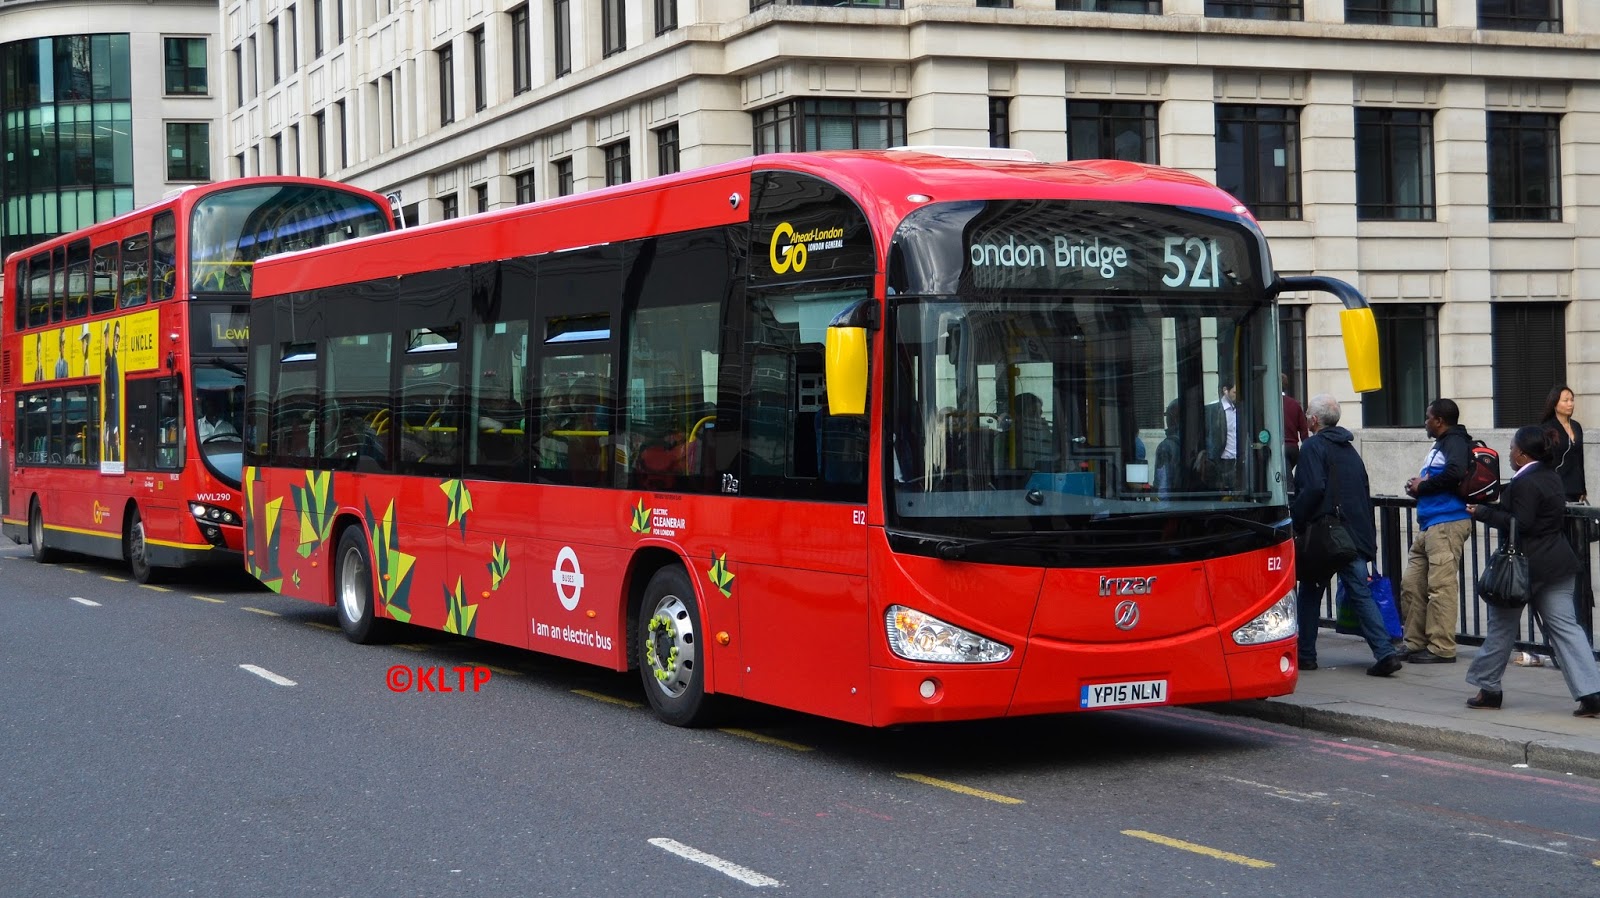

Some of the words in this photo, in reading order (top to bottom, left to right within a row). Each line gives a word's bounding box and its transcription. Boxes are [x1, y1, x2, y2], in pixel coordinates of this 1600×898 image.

[789, 226, 843, 244] Ahead-London
[769, 222, 807, 274] Go
[807, 242, 824, 252] LONDON
[824, 239, 843, 249] GENERAL
[1054, 236, 1128, 278] Bridge
[1162, 236, 1220, 287] 521
[217, 324, 250, 340] Lewi
[130, 333, 153, 352] UNCLE
[197, 493, 231, 501] WVL290
[660, 529, 675, 537] LONDON
[562, 574, 574, 583] BUSES
[1099, 575, 1157, 596] irizar
[532, 618, 535, 634] I
[537, 622, 549, 637] am
[551, 625, 561, 640] an
[563, 625, 594, 647] electric
[596, 631, 612, 651] bus
[1094, 685, 1127, 703] YP15
[1131, 682, 1161, 701] NLN
